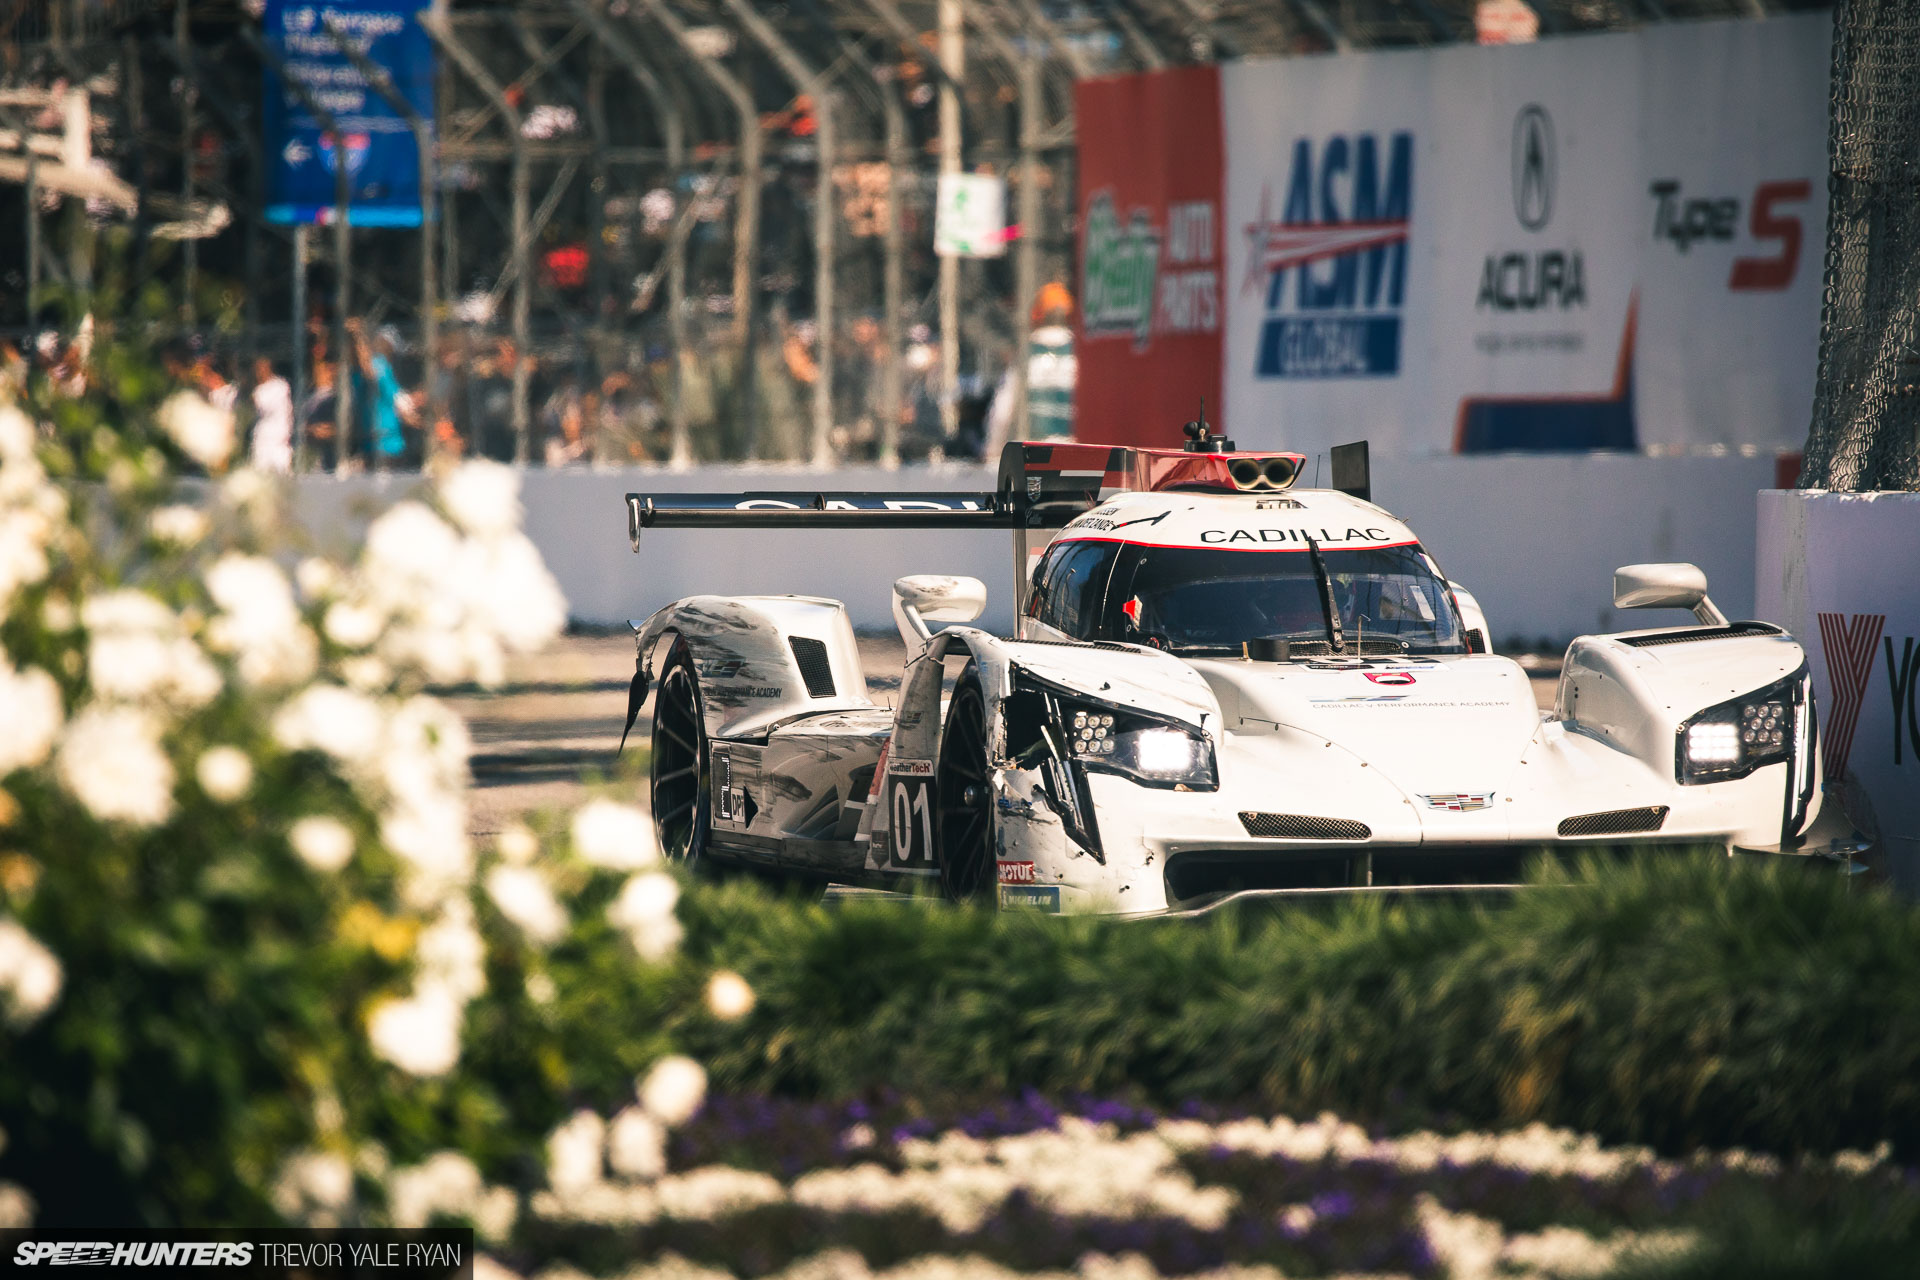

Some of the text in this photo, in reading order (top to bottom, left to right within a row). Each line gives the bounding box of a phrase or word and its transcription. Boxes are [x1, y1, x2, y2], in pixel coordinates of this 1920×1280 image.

[1267, 131, 1412, 308] ASM
[1651, 180, 1811, 291] Type S
[1476, 251, 1586, 310] ACURA
[1200, 528, 1391, 544] CADILLAC
[894, 782, 933, 861] 01
[1000, 864, 1033, 880] MOTUL
